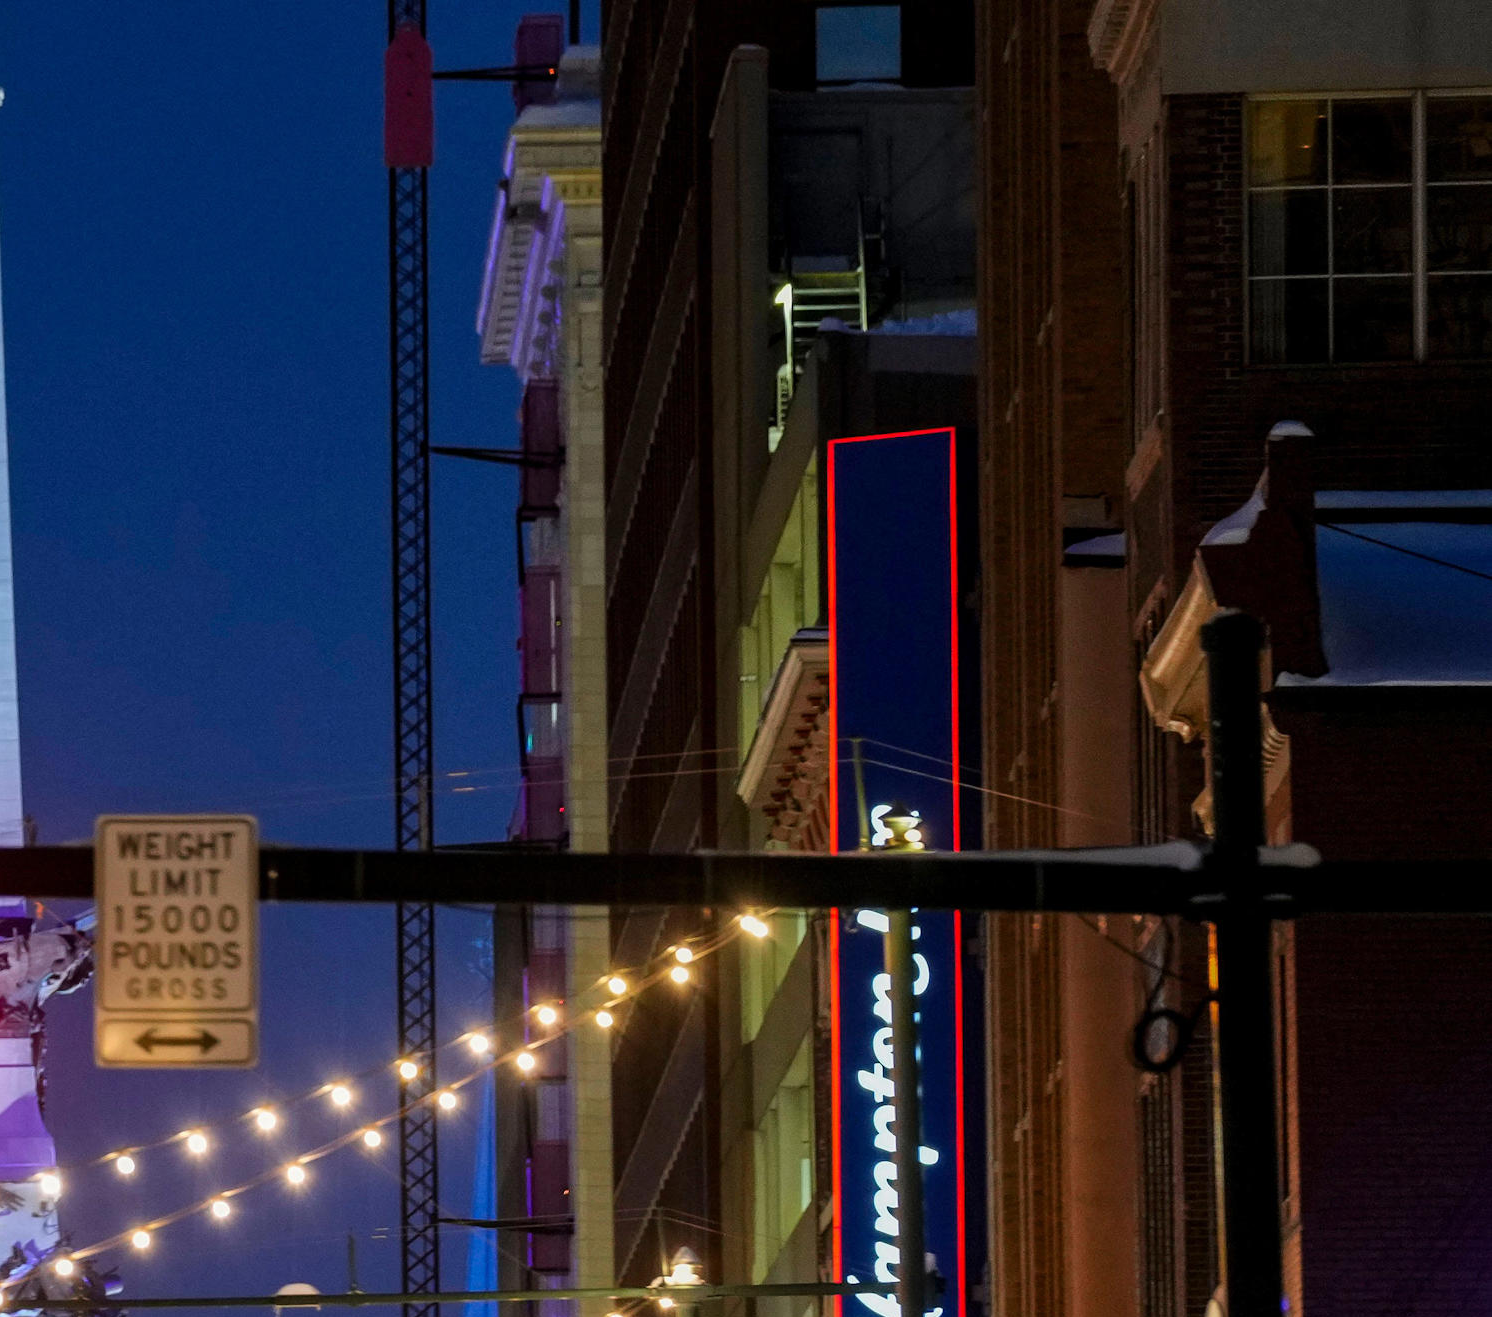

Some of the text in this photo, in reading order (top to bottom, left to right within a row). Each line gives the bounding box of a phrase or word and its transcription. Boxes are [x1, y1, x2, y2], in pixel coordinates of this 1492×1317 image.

[118, 831, 235, 860] WEIGHT
[130, 868, 220, 897] LIMIT
[113, 906, 241, 934] 15000
[113, 943, 241, 970] POUNDS
[125, 978, 228, 1000] GROSS
